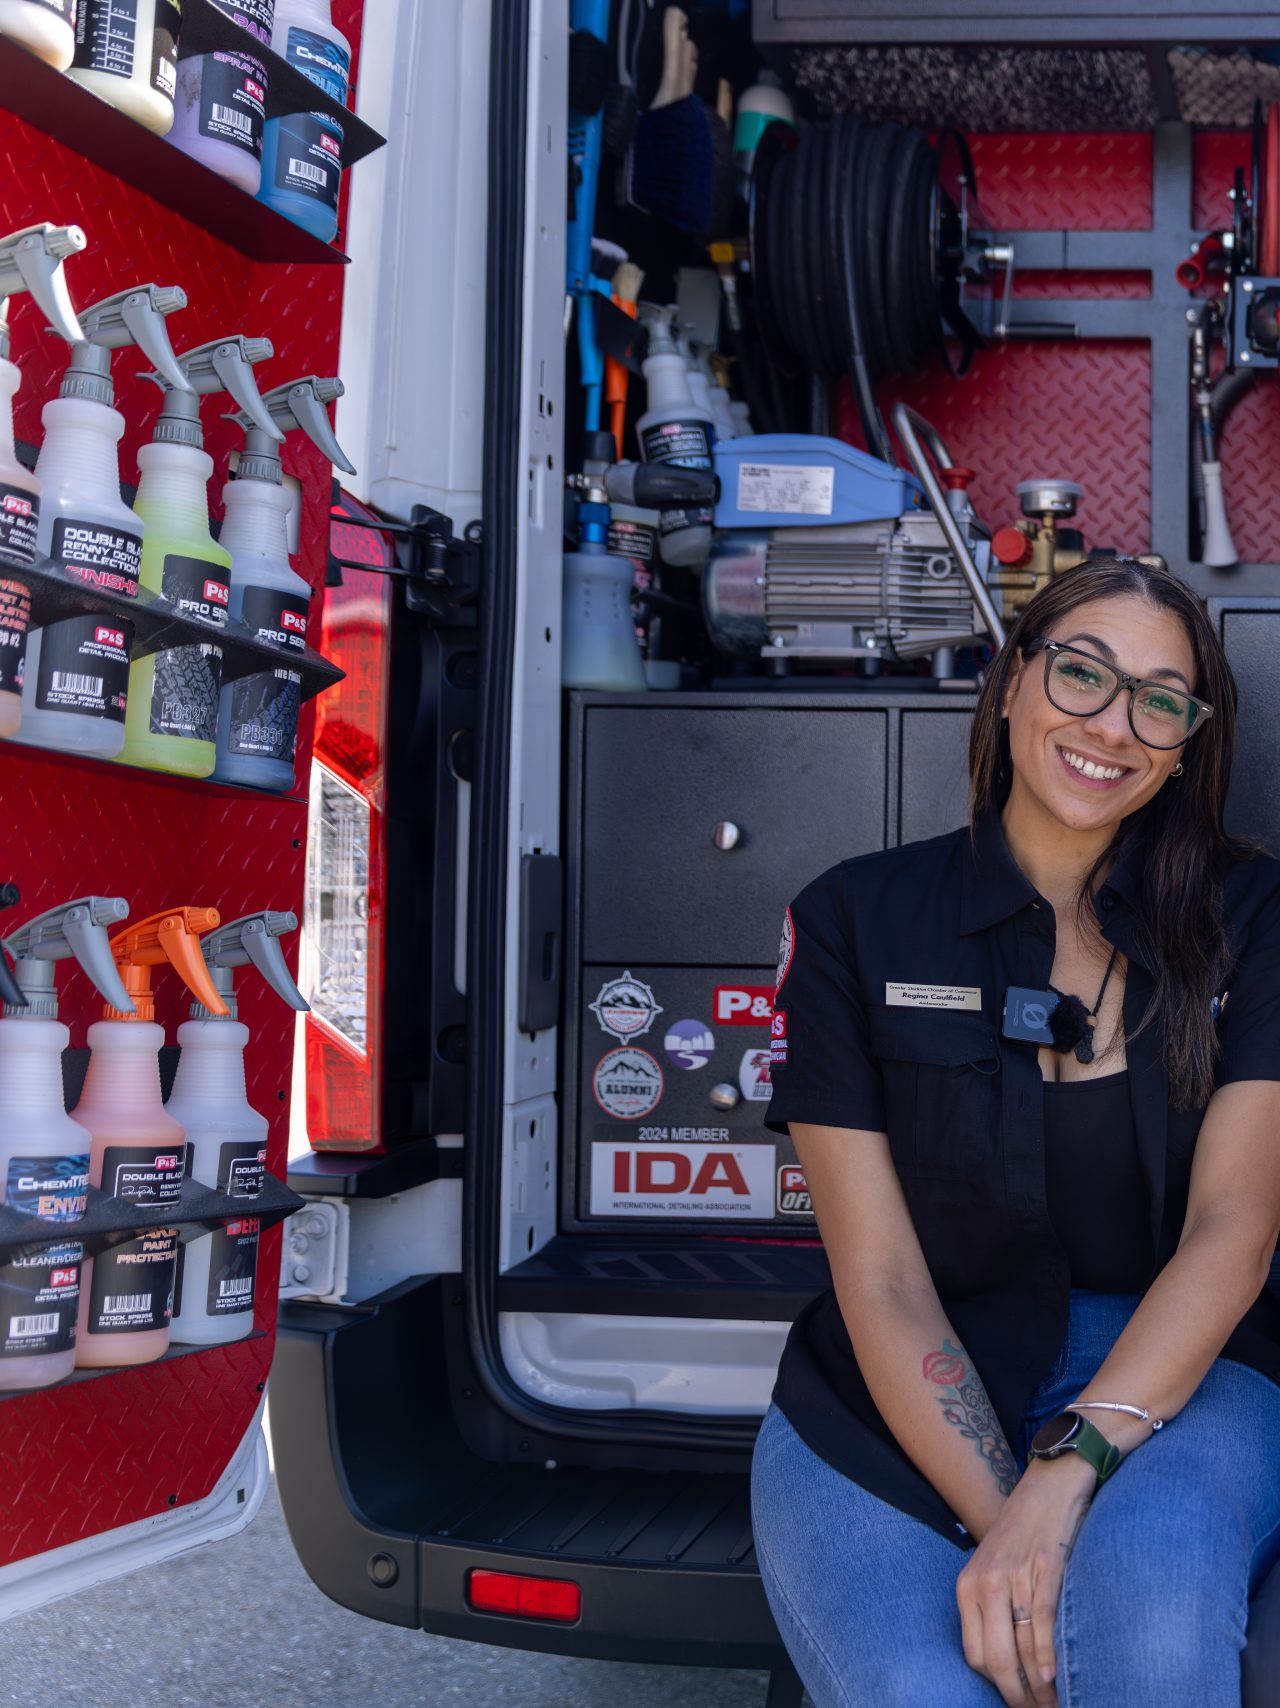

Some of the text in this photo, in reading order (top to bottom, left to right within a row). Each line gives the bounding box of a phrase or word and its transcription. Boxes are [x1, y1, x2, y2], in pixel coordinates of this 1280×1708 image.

[76, 20, 86, 44] DILUTION
[246, 80, 264, 101] P&S
[208, 120, 232, 132] STOCK
[322, 136, 340, 155] P&S
[7, 500, 28, 514] P&S
[64, 527, 124, 550] DOUBLE
[62, 540, 110, 556] RENNY
[62, 550, 139, 576] COLLECTION
[206, 583, 229, 601] P&S
[178, 600, 210, 615] PRO
[284, 612, 306, 632] P&S
[98, 628, 124, 646] P&S
[258, 628, 287, 643] PRO
[78, 647, 103, 657] DETAIL
[274, 668, 288, 680] Tire
[47, 692, 76, 700] STOCK
[162, 701, 208, 724] PB327
[240, 723, 283, 746] PB331
[718, 990, 774, 1019] P&
[902, 992, 966, 1002] Regina Caulfield
[606, 1084, 652, 1096] ALUMNI
[638, 1126, 730, 1142] 2024 MEMBER
[157, 1159, 176, 1168] P&S
[613, 1151, 751, 1195] IDA
[704, 1203, 752, 1211] ASSOCIATION
[142, 1240, 172, 1250] PAINT
[54, 1270, 77, 1284] P&S
[34, 1294, 58, 1303] DETAIL
